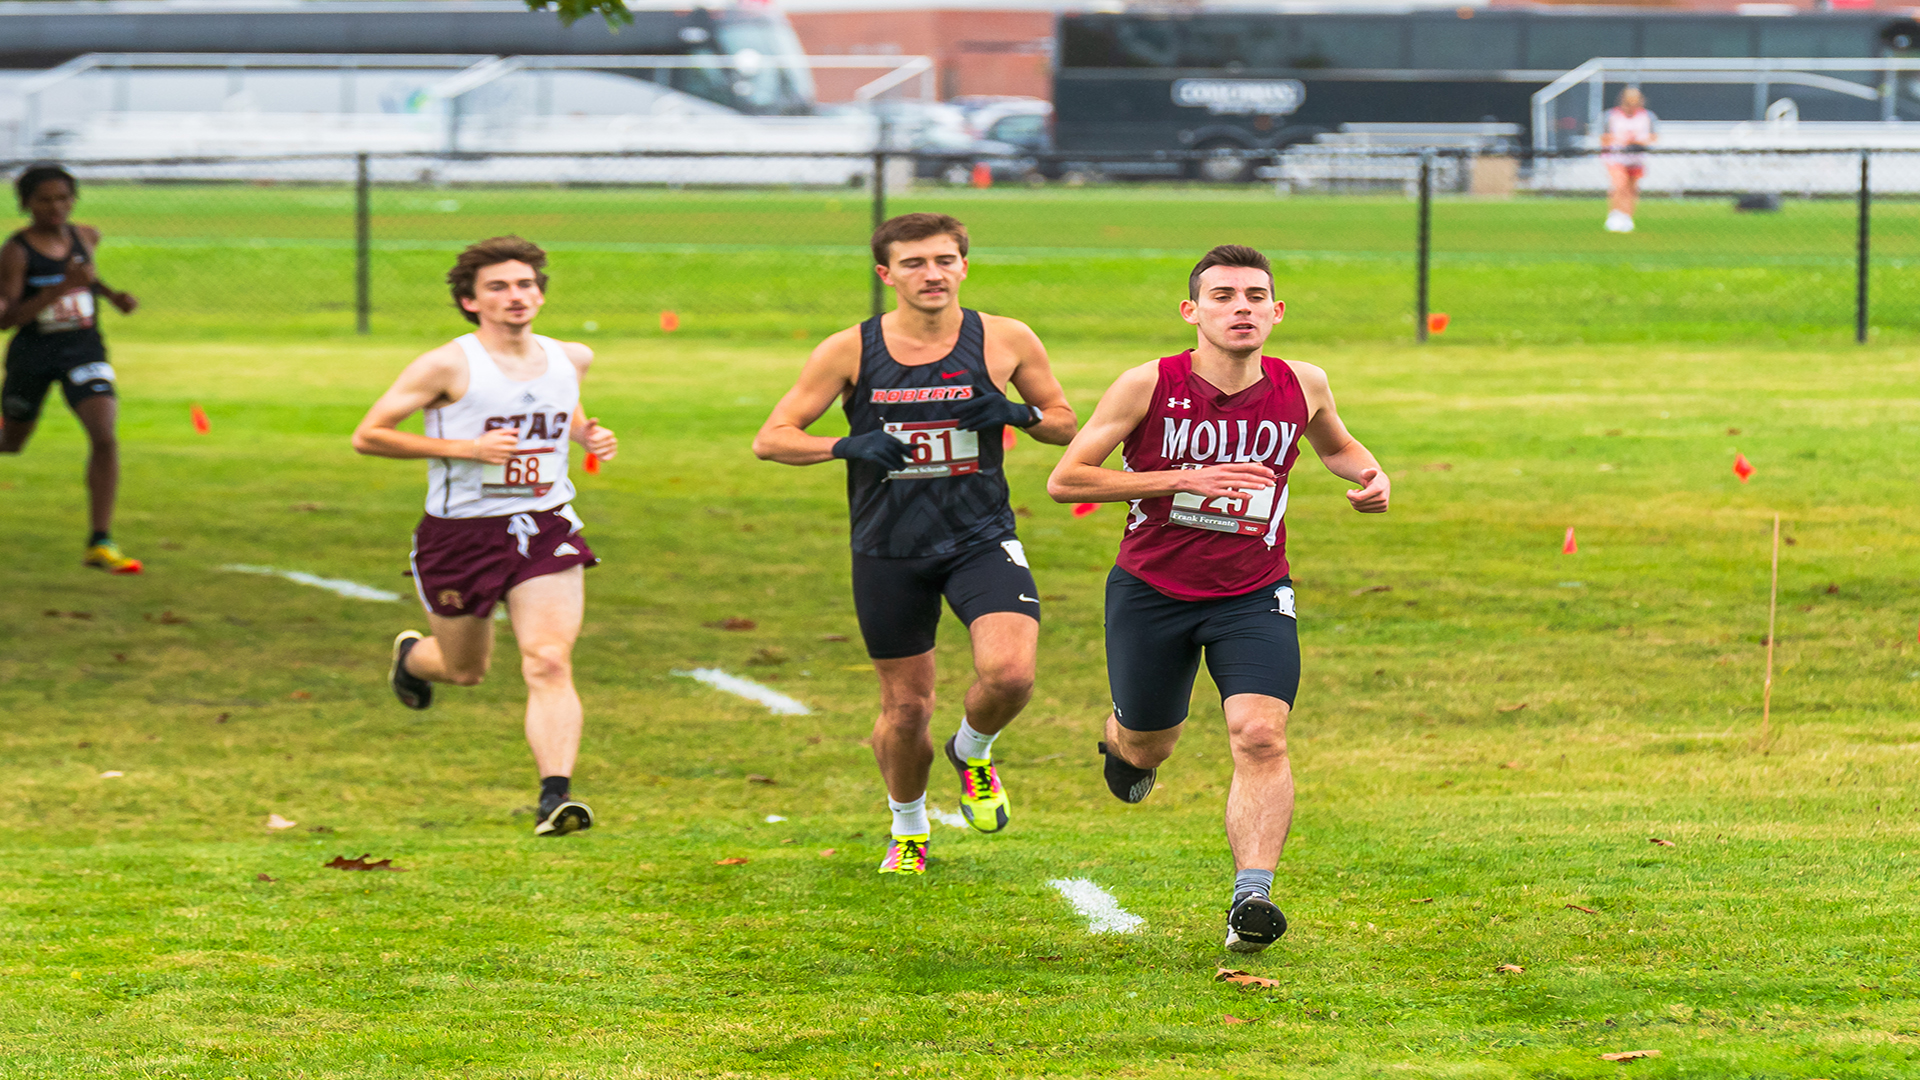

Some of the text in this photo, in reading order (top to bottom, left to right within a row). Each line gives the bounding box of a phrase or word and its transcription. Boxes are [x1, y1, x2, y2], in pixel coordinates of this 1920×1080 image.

[870, 385, 975, 404] ROBERTS
[909, 430, 953, 464] 61
[1160, 416, 1298, 466] MOLLOY
[504, 456, 540, 485] 68
[1172, 512, 1236, 528] Frank Ferrante
